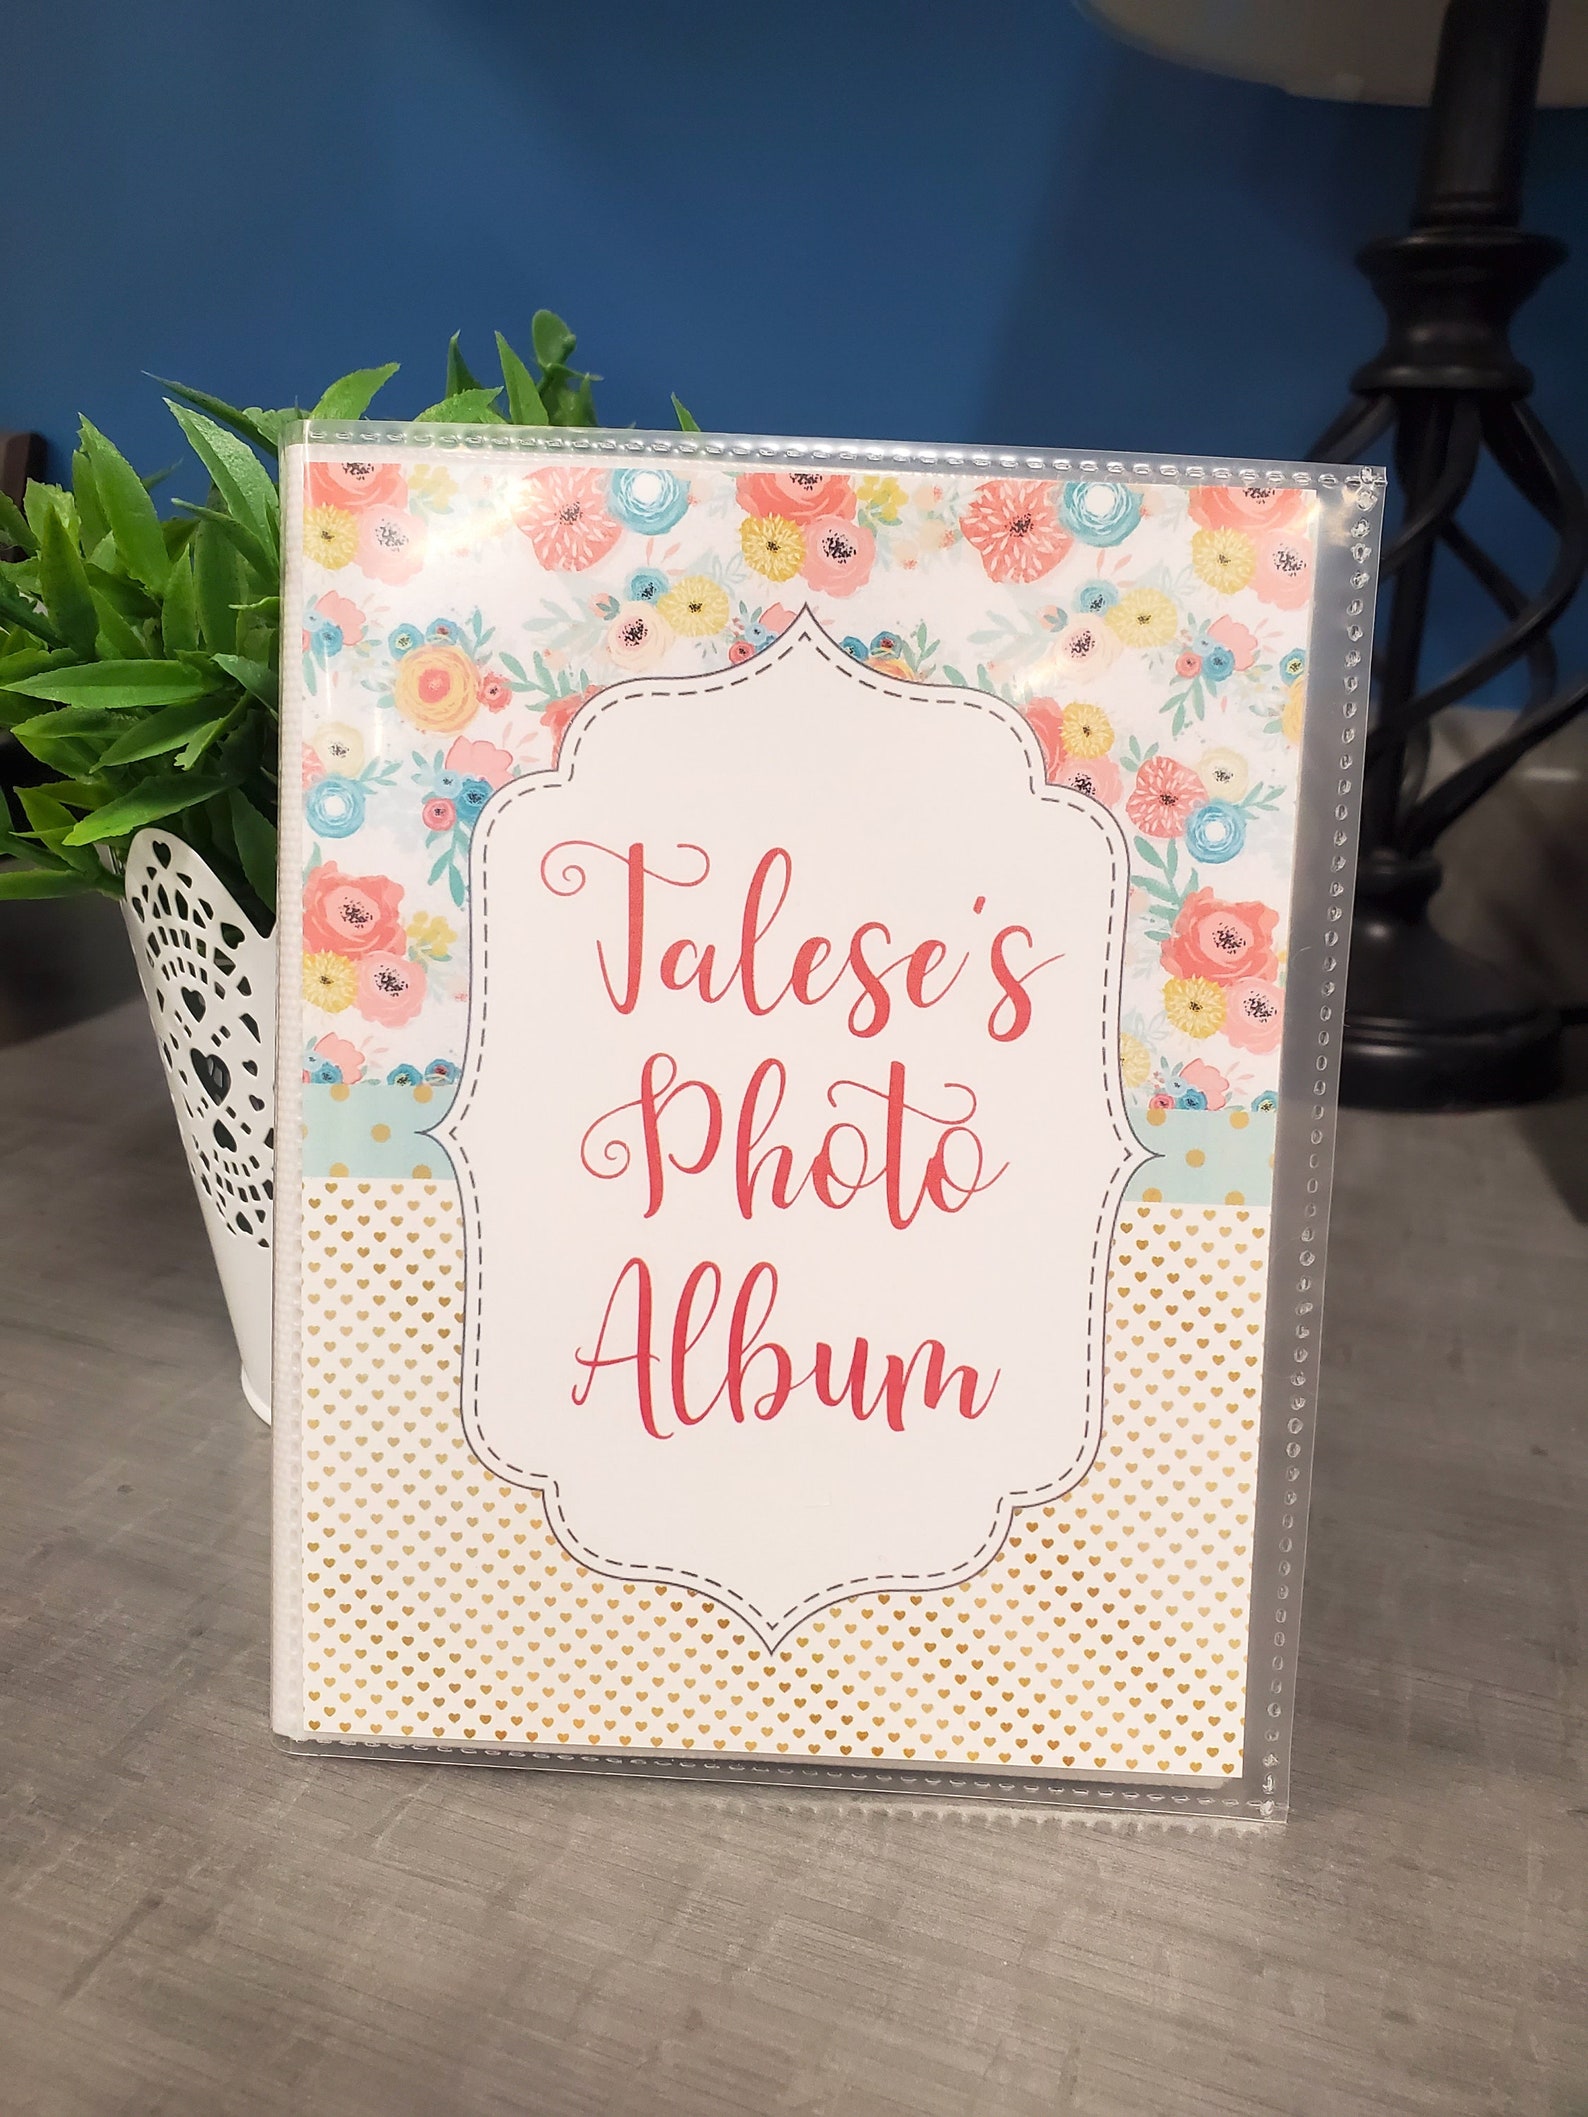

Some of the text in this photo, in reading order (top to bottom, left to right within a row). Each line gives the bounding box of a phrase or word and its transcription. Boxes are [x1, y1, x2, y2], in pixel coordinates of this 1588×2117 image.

[540, 840, 1066, 1042] Talese's
[580, 1052, 1010, 1230] Photo
[571, 1257, 1001, 1440] Album
